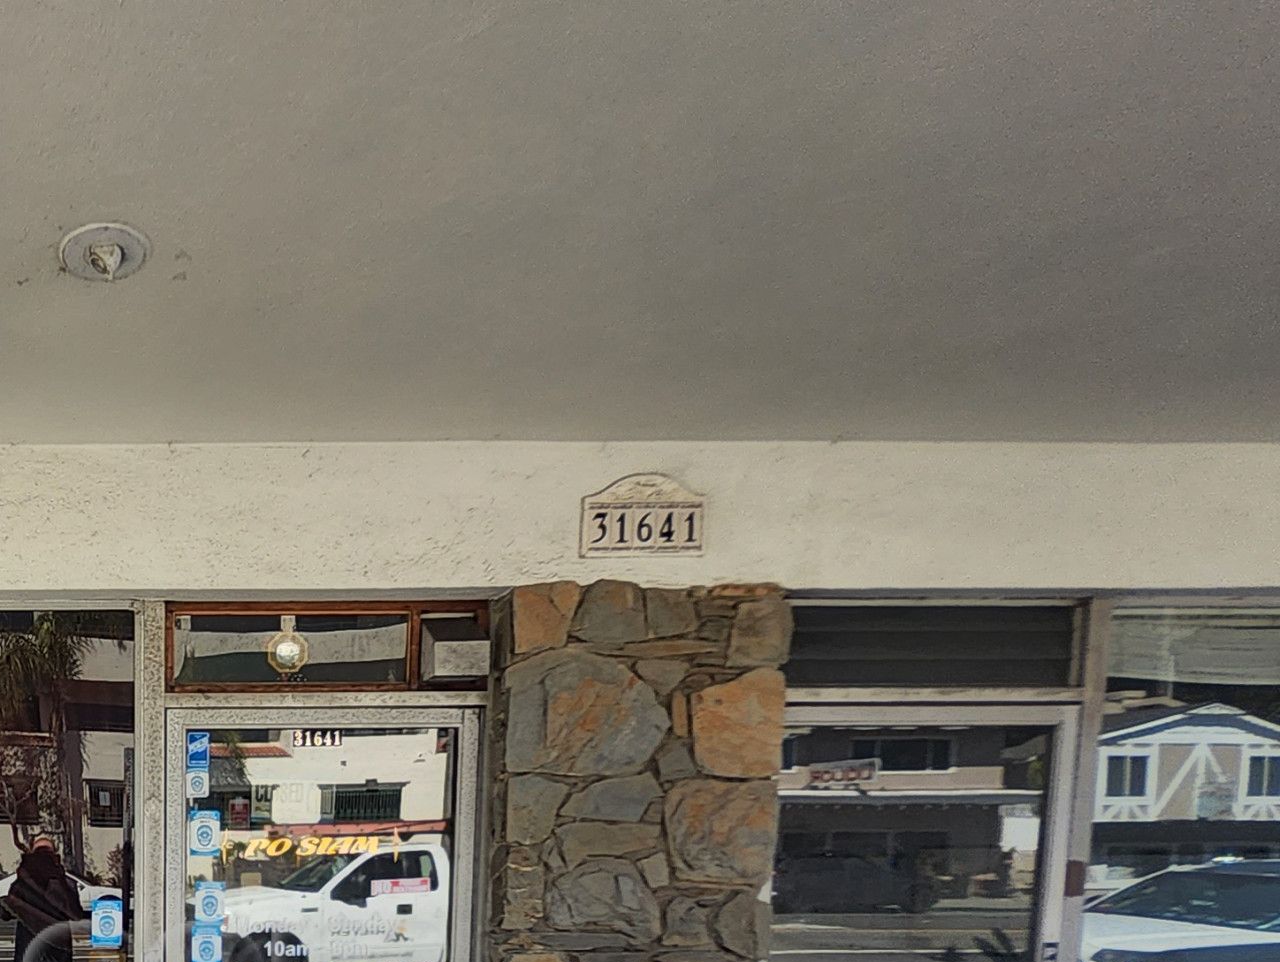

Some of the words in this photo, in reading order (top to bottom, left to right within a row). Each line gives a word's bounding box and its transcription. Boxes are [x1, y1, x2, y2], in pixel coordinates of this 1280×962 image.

[591, 511, 697, 544] 31641
[293, 730, 341, 746] 31641
[244, 838, 292, 860] PO
[296, 836, 379, 857] SIAM
